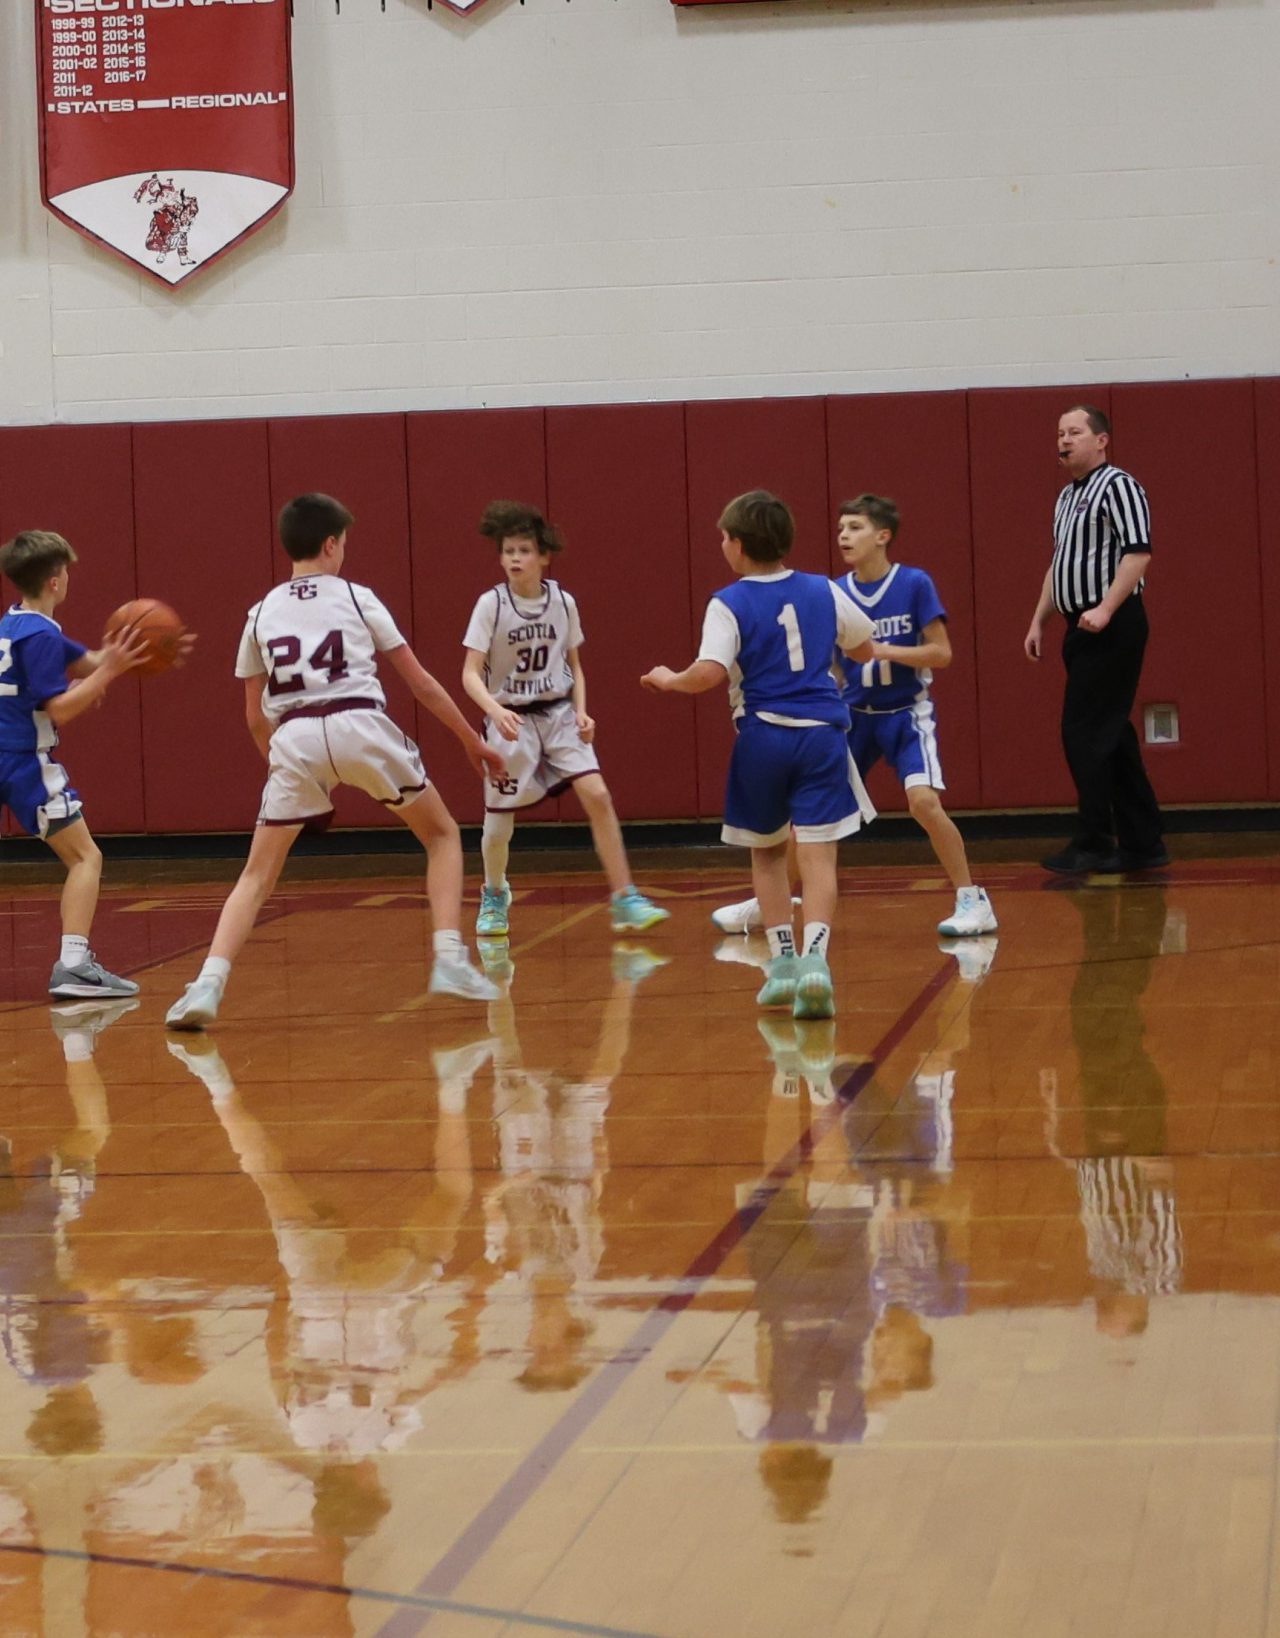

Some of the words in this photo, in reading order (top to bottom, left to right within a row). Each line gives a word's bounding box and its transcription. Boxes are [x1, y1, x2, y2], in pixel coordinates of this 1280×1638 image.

[51, 17, 95, 30] 1998-99
[102, 15, 144, 28] 2012-13
[52, 31, 97, 43] 1999-00
[102, 28, 146, 42] 2013-14
[52, 44, 97, 57] 2000-01
[103, 43, 146, 56] 2014-15
[52, 58, 98, 70] 2001-02
[104, 56, 146, 69] 2015-16
[53, 72, 76, 84] 2011
[104, 71, 146, 84] 2016-17
[54, 85, 93, 97] 2011-12
[508, 623, 557, 646] SCOTIA
[776, 603, 806, 672] 1
[267, 629, 350, 697] 24
[516, 645, 549, 673] 30
